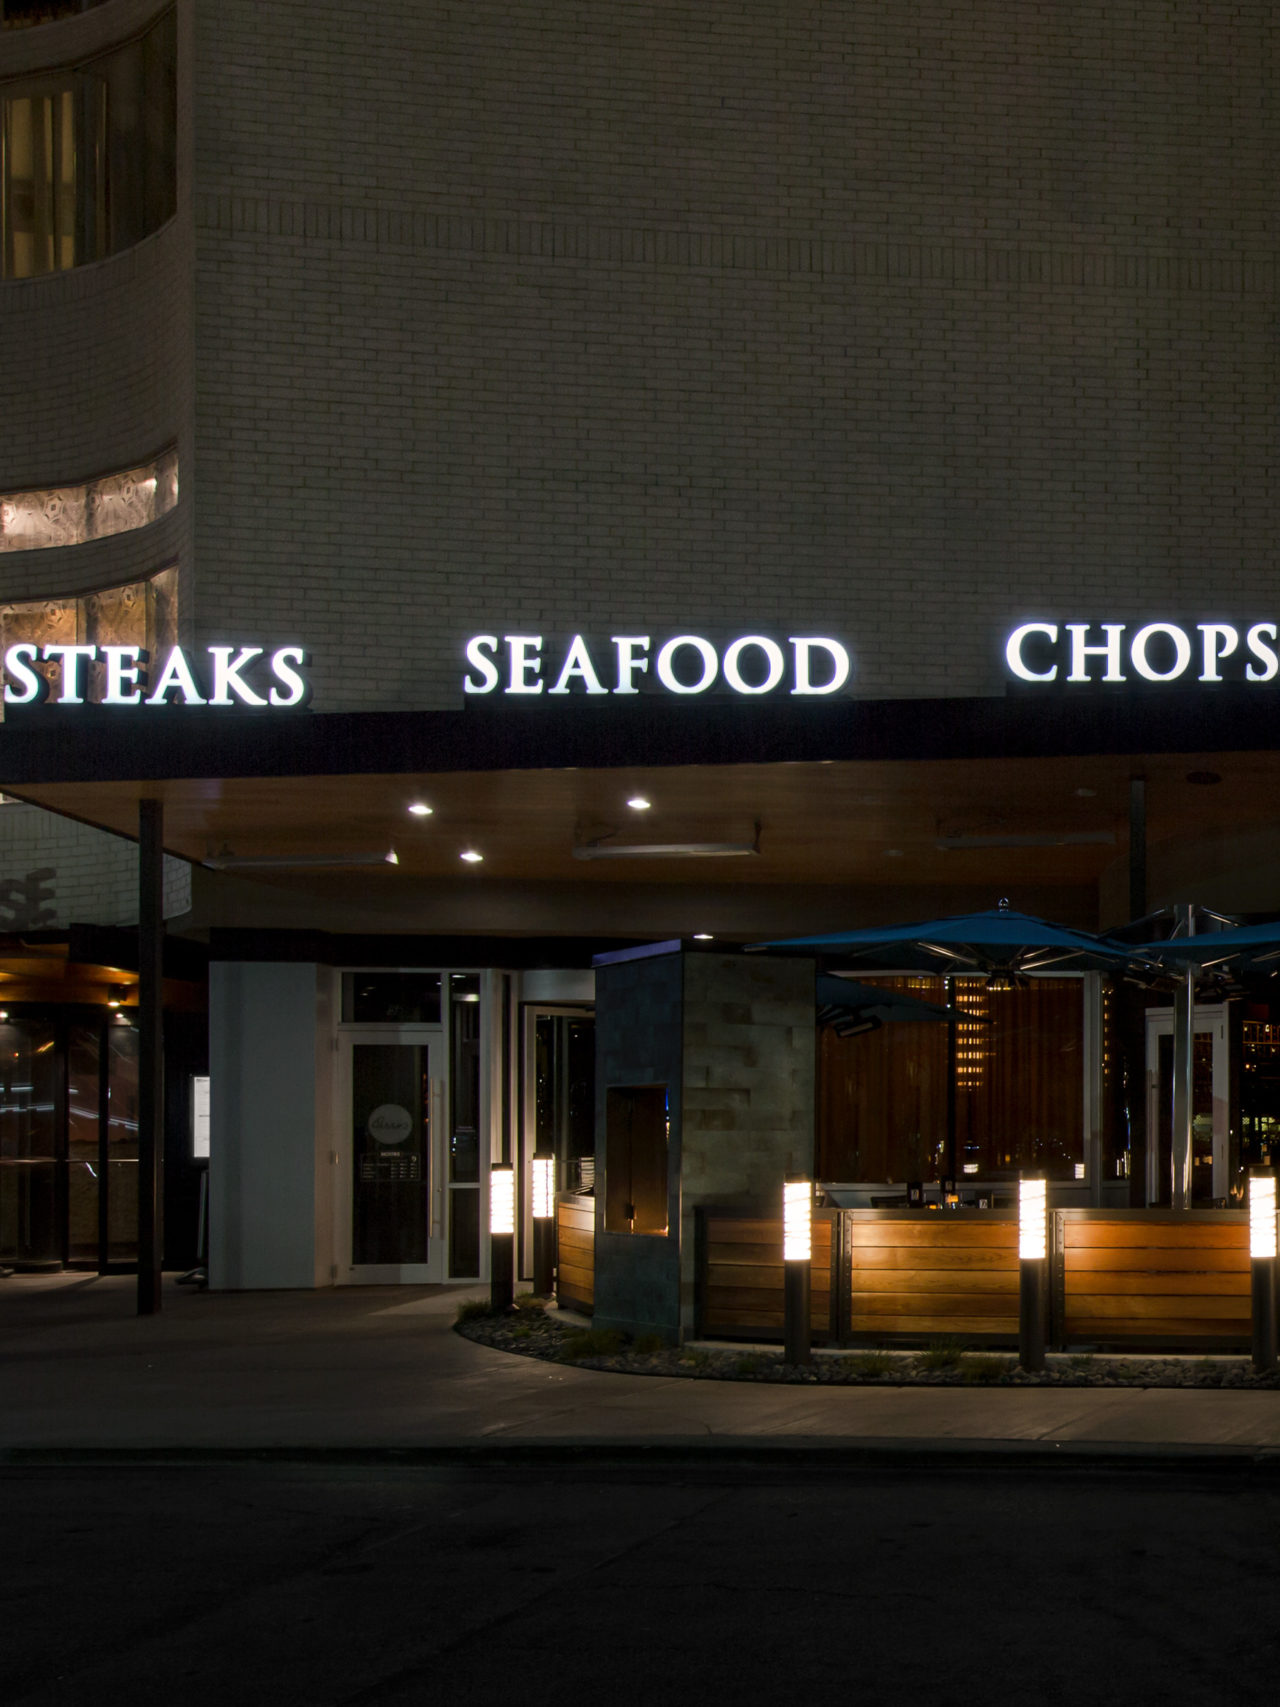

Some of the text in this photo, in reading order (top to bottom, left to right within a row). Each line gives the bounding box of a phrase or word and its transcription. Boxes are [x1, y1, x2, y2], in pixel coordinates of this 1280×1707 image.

[4, 642, 304, 706] STEAKS
[464, 634, 850, 695] SEAFOOD
[1006, 622, 1279, 682] CHOPS
